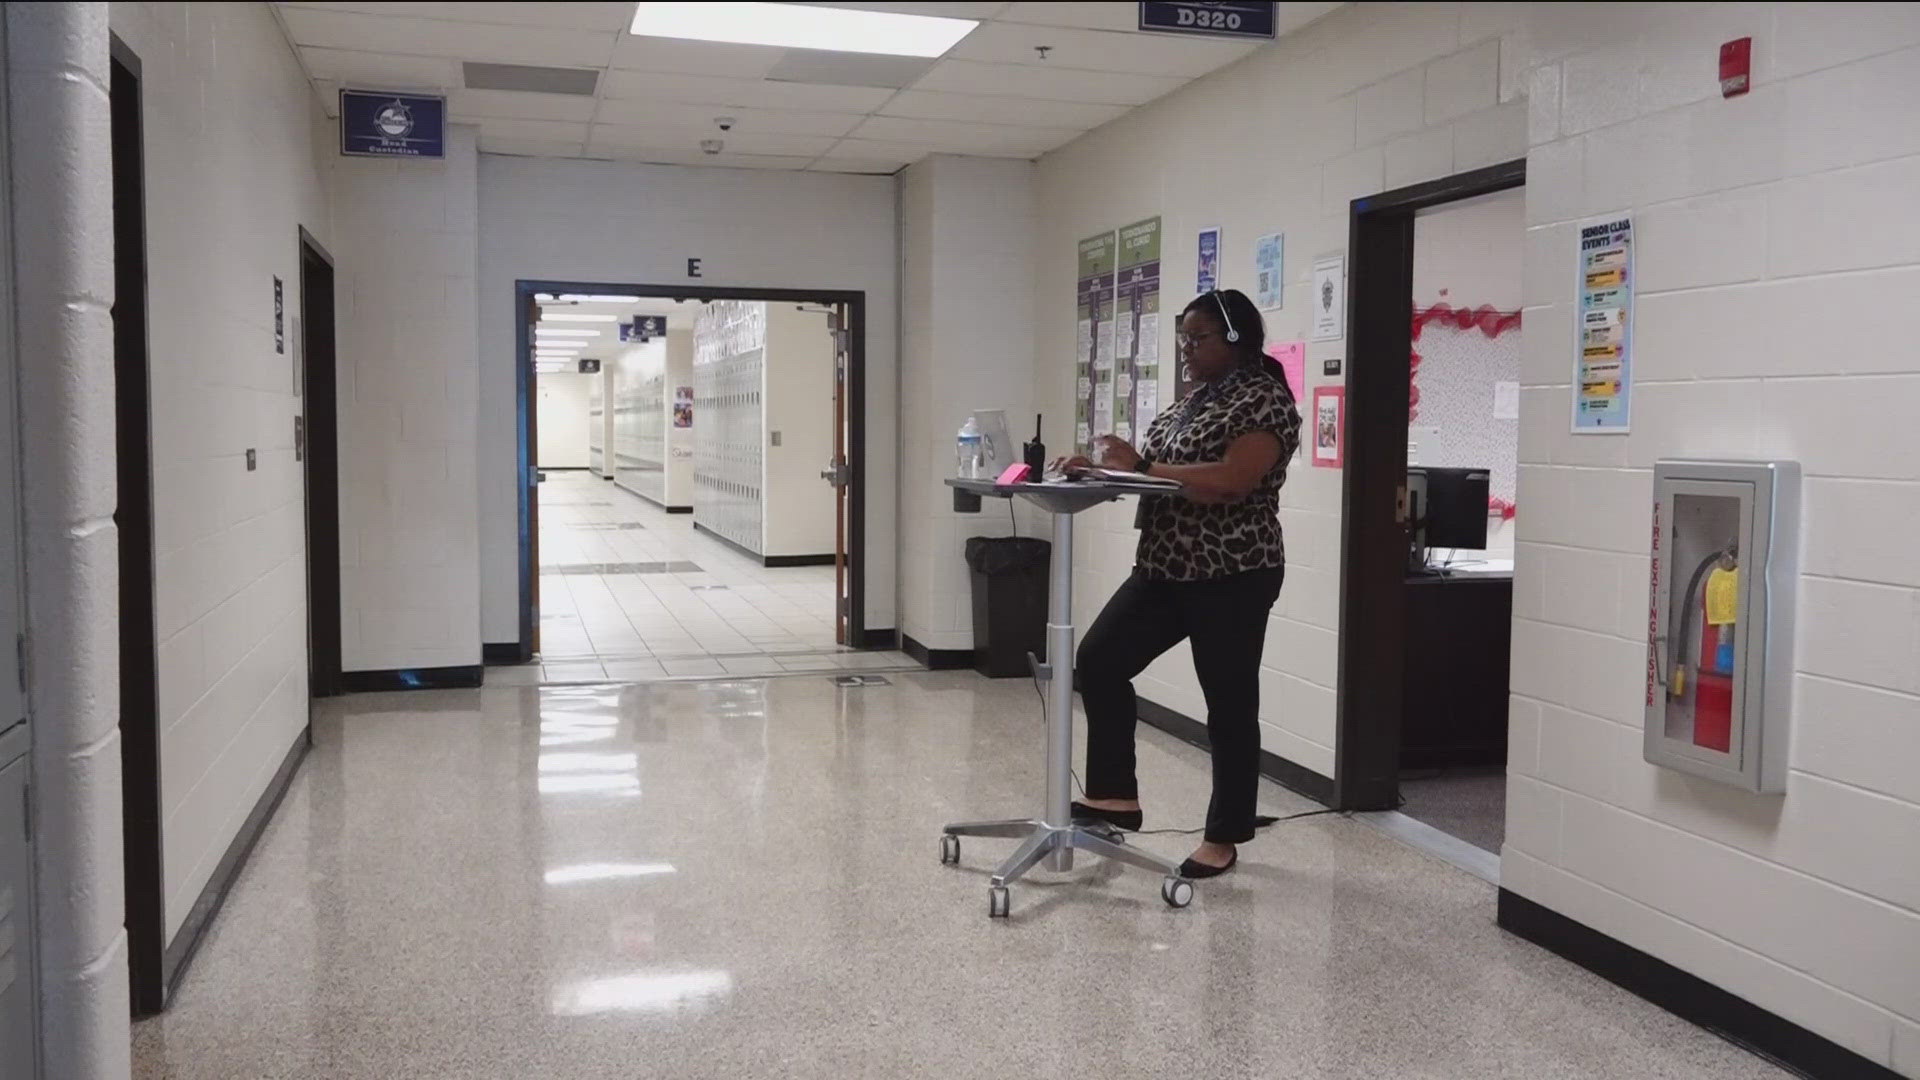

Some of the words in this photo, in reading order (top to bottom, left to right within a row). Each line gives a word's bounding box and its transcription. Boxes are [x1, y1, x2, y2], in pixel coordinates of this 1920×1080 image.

[1177, 8, 1241, 29] D320
[369, 146, 418, 154] Custodian
[381, 139, 407, 147] Head
[1582, 224, 1609, 239] SENIOR
[1610, 219, 1630, 231] CLASS
[1582, 235, 1610, 250] EVENTS
[688, 258, 702, 277] E
[1648, 559, 1659, 706] EXTINGUISHER
